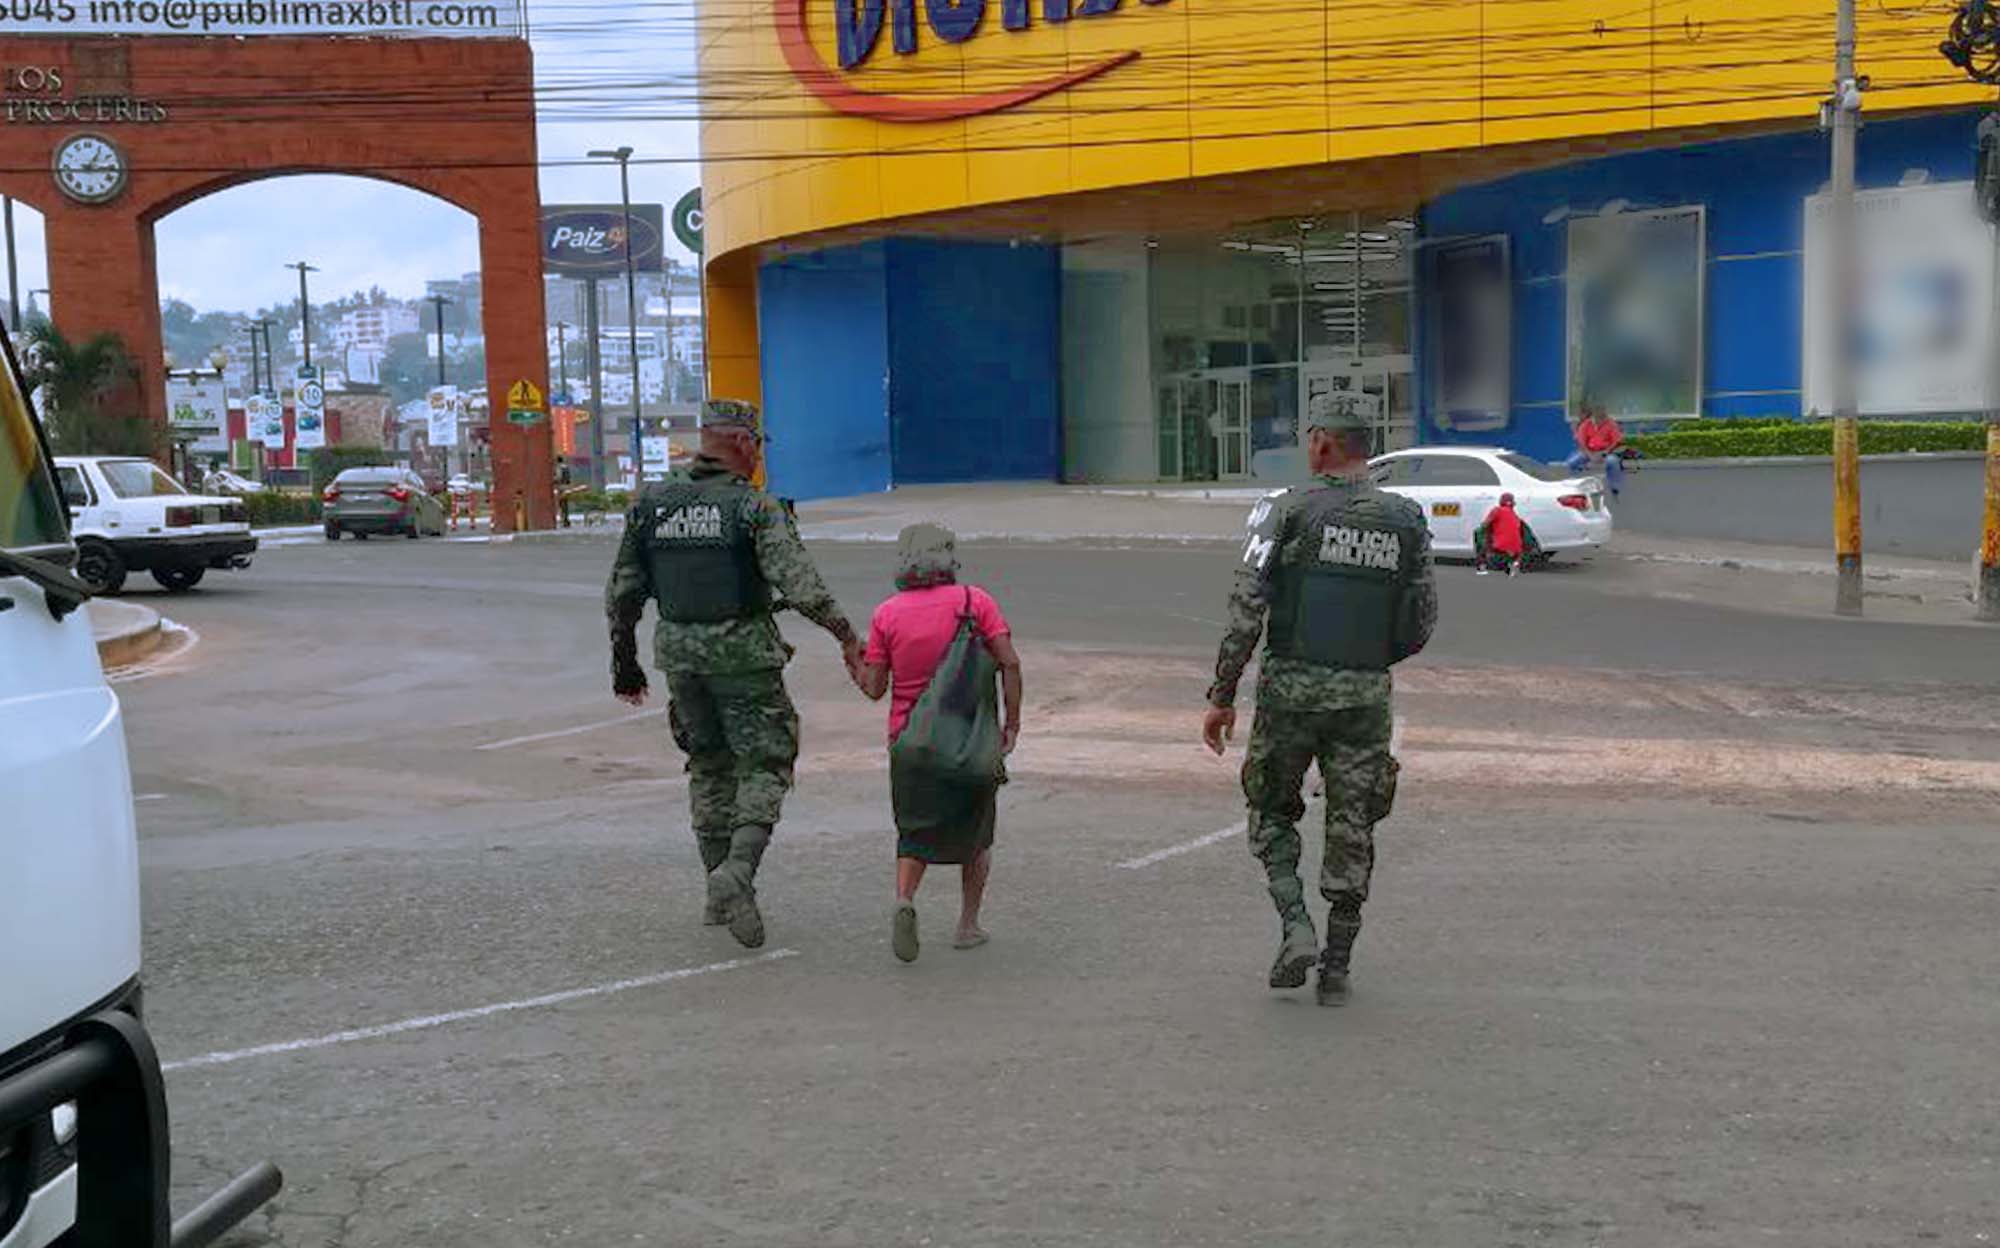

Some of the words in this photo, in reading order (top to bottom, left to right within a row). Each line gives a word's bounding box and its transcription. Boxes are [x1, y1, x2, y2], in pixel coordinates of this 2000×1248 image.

[91, 0, 499, 30] info@publimaxbtl.com
[7, 66, 62, 91] LOS
[7, 99, 168, 121] PROCERES
[551, 226, 605, 250] Paiz
[655, 520, 721, 538] MILITAR
[1323, 525, 1400, 551] POLICIA
[1319, 543, 1399, 570] MILITAR
